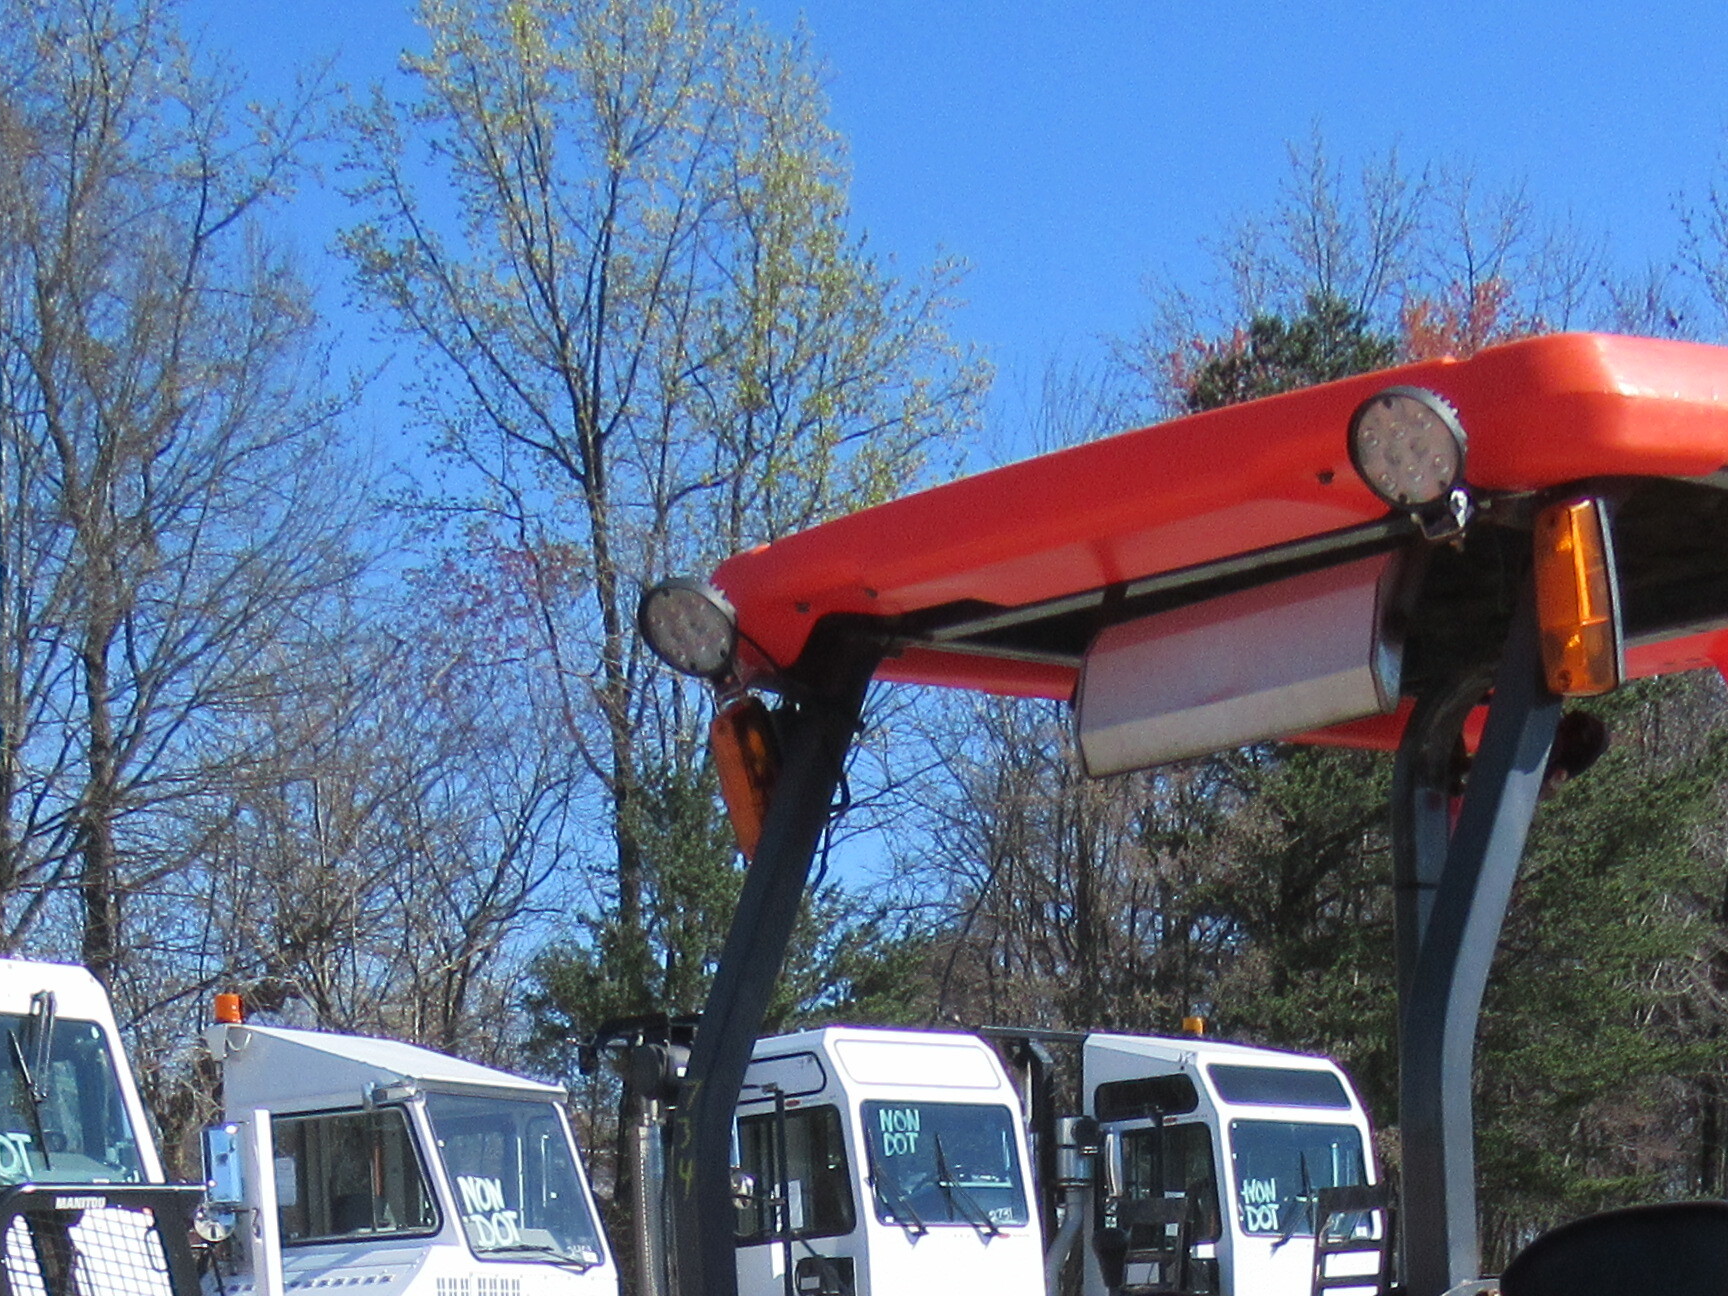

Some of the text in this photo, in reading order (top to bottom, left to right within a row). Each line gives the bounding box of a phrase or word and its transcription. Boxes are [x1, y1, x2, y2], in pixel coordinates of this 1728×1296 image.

[878, 1108, 920, 1132] NON
[882, 1131, 919, 1157] DOT
[54, 1196, 107, 1210] MANITOU
[456, 1175, 506, 1214] NON
[1240, 1177, 1277, 1204] NON
[469, 1209, 522, 1247] DOT
[1244, 1203, 1280, 1232] DOT
